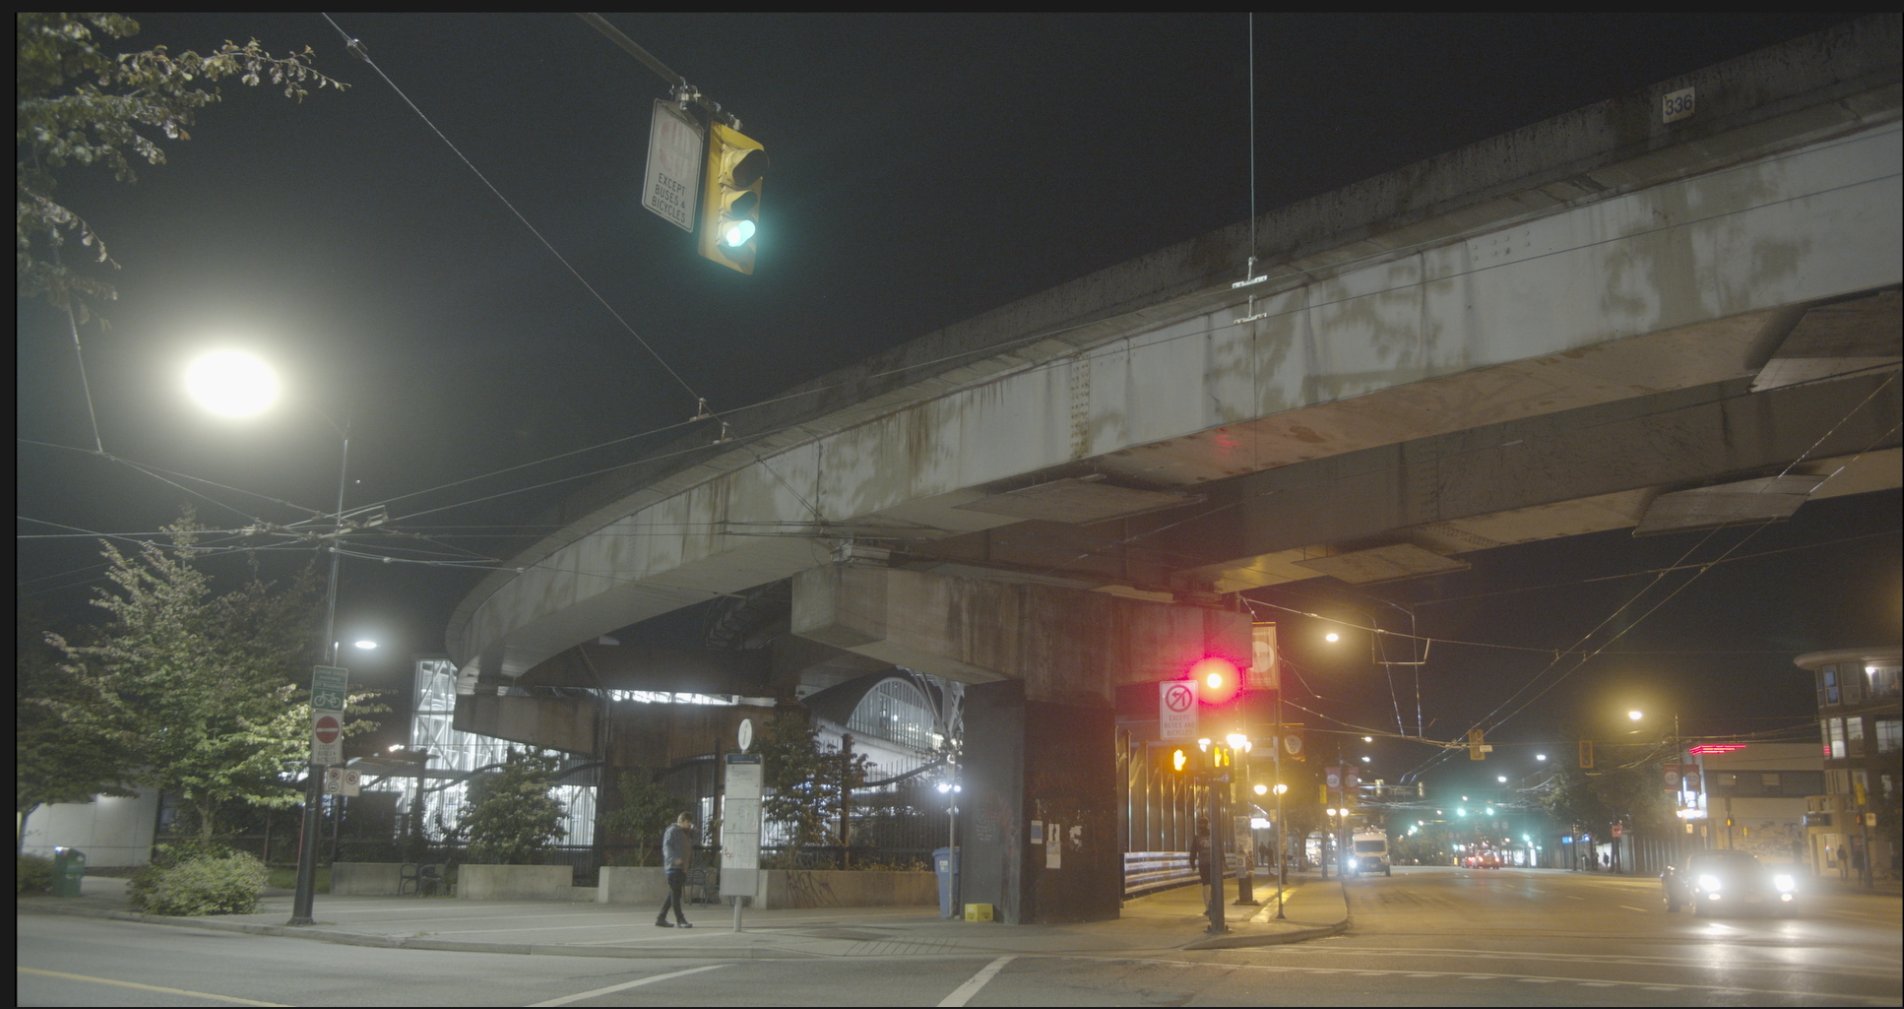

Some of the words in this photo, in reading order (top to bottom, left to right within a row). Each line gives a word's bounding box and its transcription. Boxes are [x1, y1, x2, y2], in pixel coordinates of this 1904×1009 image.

[1664, 93, 1693, 116] 336
[655, 183, 679, 206] BUSES
[658, 172, 686, 197] EXCEPT
[651, 194, 686, 223] BICYCLES
